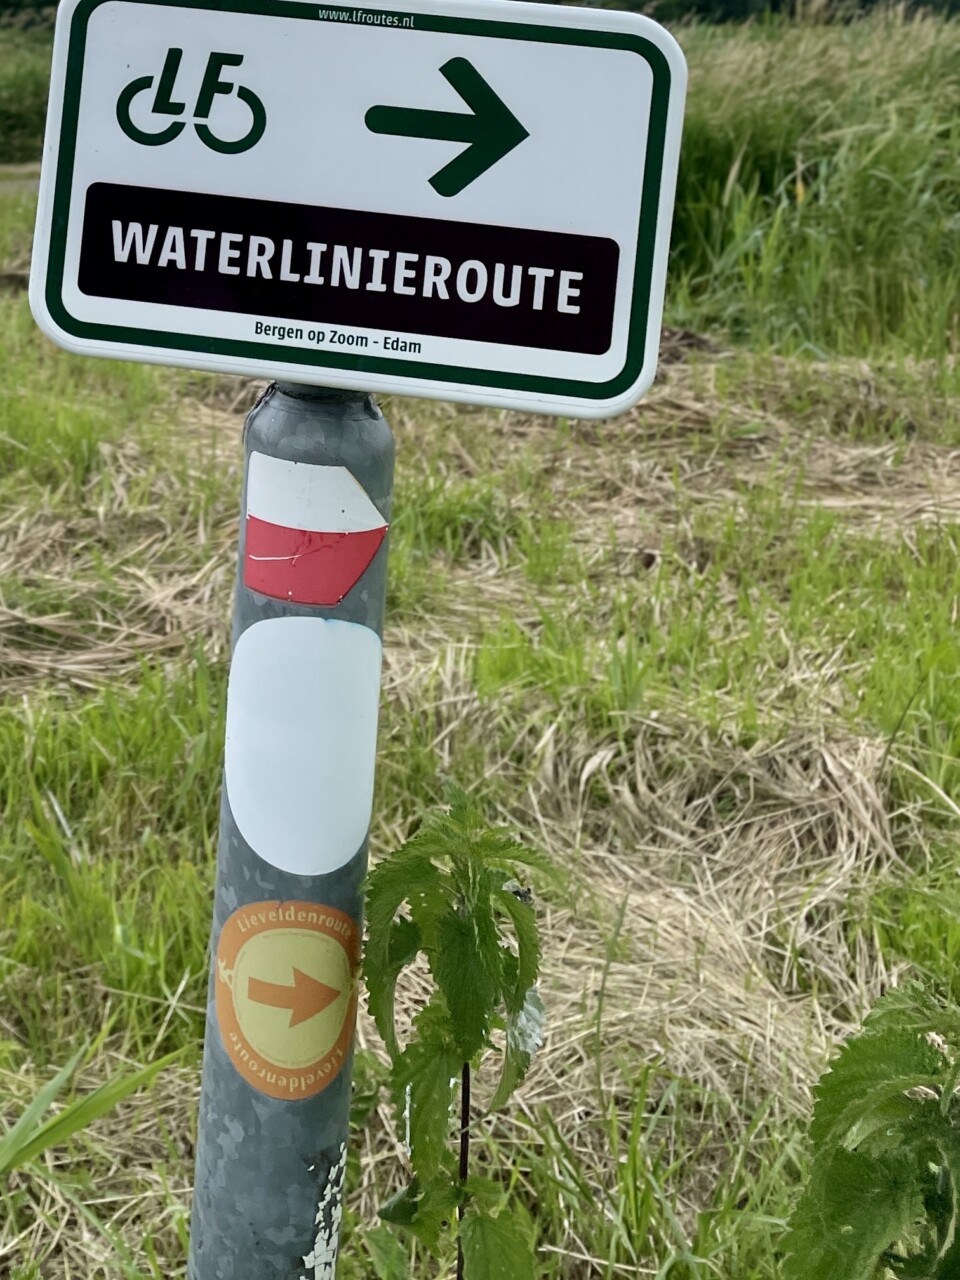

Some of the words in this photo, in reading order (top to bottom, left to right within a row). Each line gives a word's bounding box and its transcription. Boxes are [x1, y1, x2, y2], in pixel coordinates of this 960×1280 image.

[318, 9, 415, 28] www.lfroutes.nl
[111, 219, 584, 315] WATERLINIEROUTE
[254, 321, 303, 340] Bergen
[307, 329, 325, 344] op
[329, 330, 368, 347] Zoom
[383, 336, 422, 354] Edam
[237, 906, 352, 939] Lieveldenroute
[229, 1031, 343, 1092] Lieveldenroute
